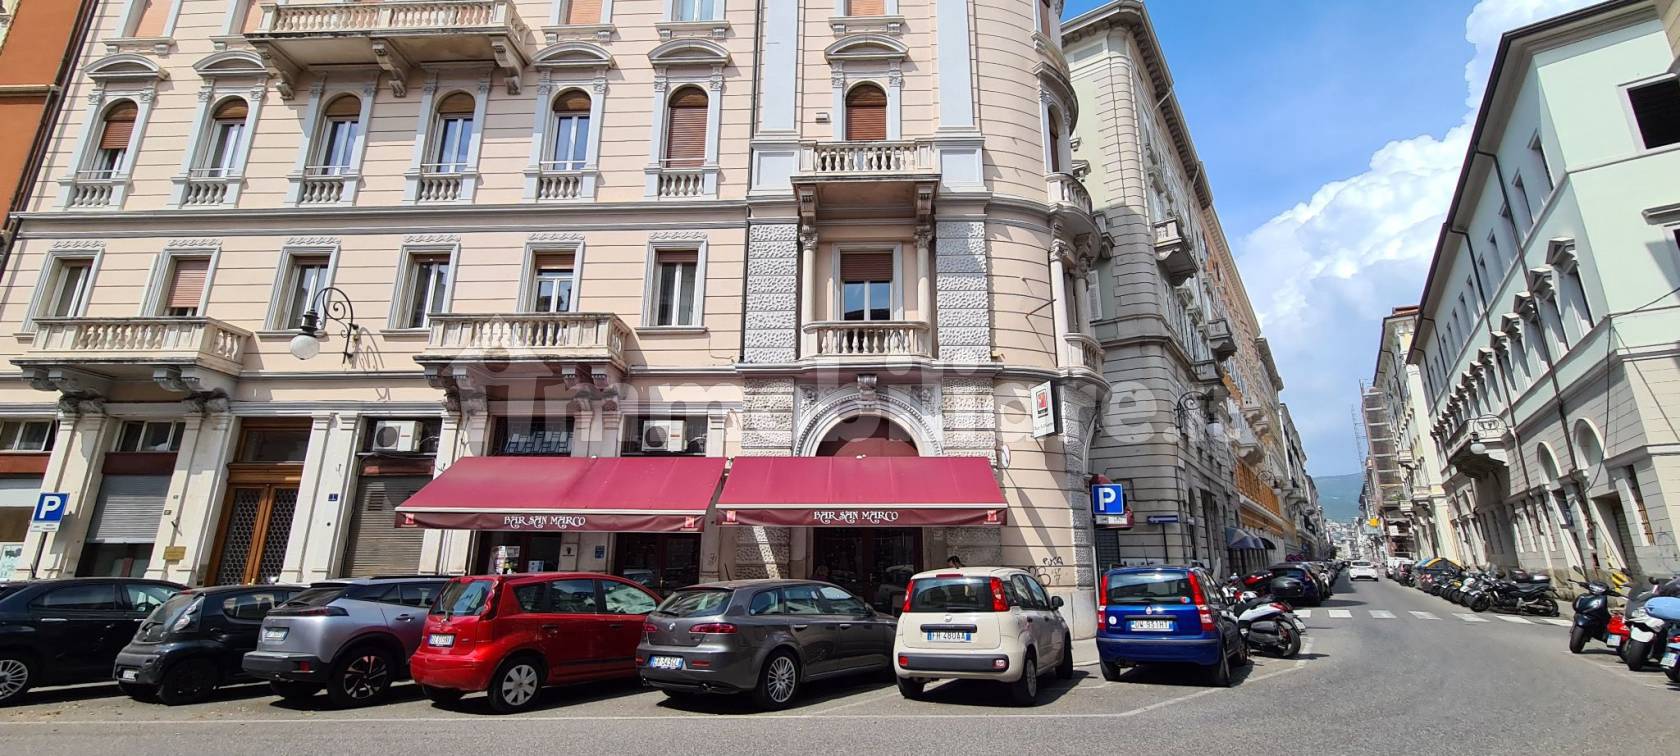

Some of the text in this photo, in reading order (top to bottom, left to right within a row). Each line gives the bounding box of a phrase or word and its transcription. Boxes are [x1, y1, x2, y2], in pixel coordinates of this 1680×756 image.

[39, 495, 61, 519] P
[1098, 487, 1116, 511] P
[503, 515, 586, 529] BAR SAN MARCO
[813, 510, 899, 524] BAR SAN MARCO
